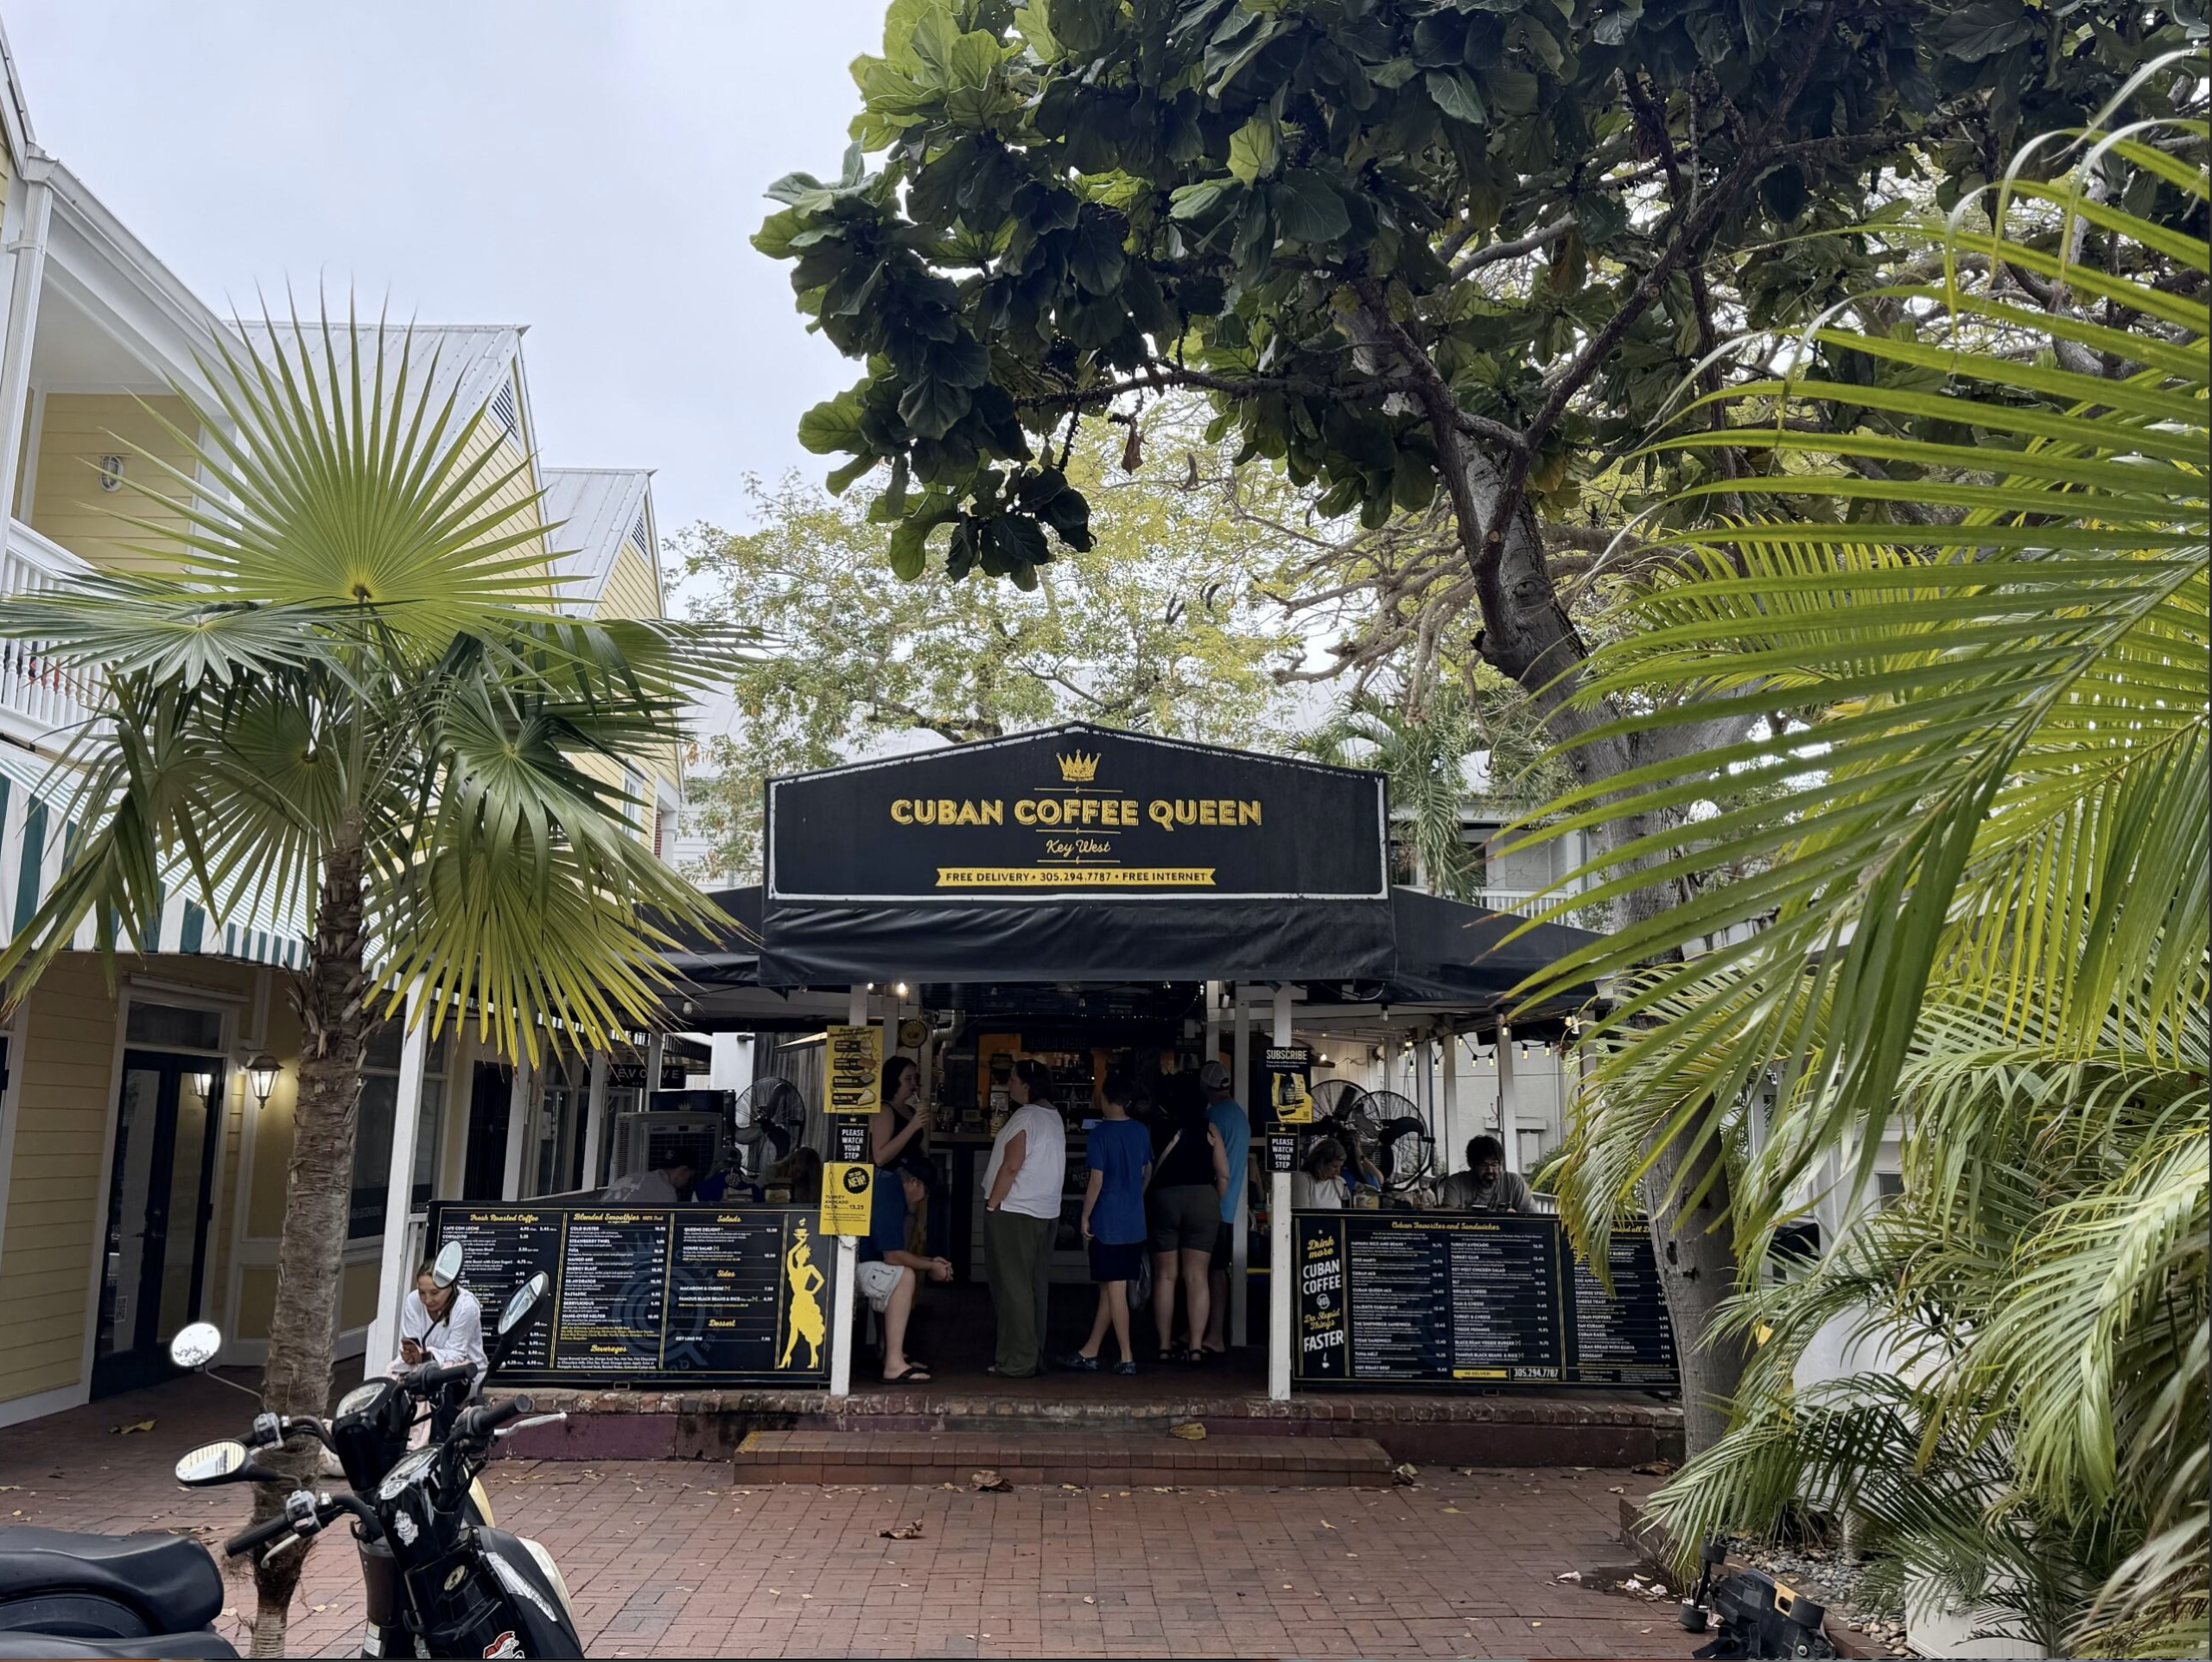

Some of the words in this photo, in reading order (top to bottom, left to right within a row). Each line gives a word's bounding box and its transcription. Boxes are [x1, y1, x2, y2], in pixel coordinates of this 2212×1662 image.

[890, 799, 1003, 825] CUBAN
[1014, 799, 1139, 825] COFFEE
[1148, 799, 1262, 831] QUEEN
[1046, 839, 1075, 857] Key
[1076, 838, 1111, 853] West
[945, 872, 973, 882] FREE
[976, 872, 1030, 882] DELIVERY
[1039, 872, 1111, 882] 305.294.7787
[1122, 872, 1149, 881] FREE
[1152, 872, 1206, 881] INTERNET
[1266, 1049, 1307, 1060] SUBSCRIBE
[618, 1068, 680, 1079] EVOVE
[848, 1175, 867, 1188] NEW!
[604, 1213, 639, 1221] Smoothies
[1306, 1235, 1335, 1251] Drink
[1308, 1247, 1333, 1259] more
[1302, 1258, 1340, 1279] CUBAN
[1302, 1275, 1341, 1295] COFFEE
[1304, 1314, 1316, 1323] Do
[1317, 1308, 1341, 1321] Stupid
[1309, 1320, 1336, 1330] Things
[1303, 1329, 1344, 1353] FASTER
[590, 1345, 627, 1354] Beverages
[1514, 1368, 1559, 1377] 305.294.7787
